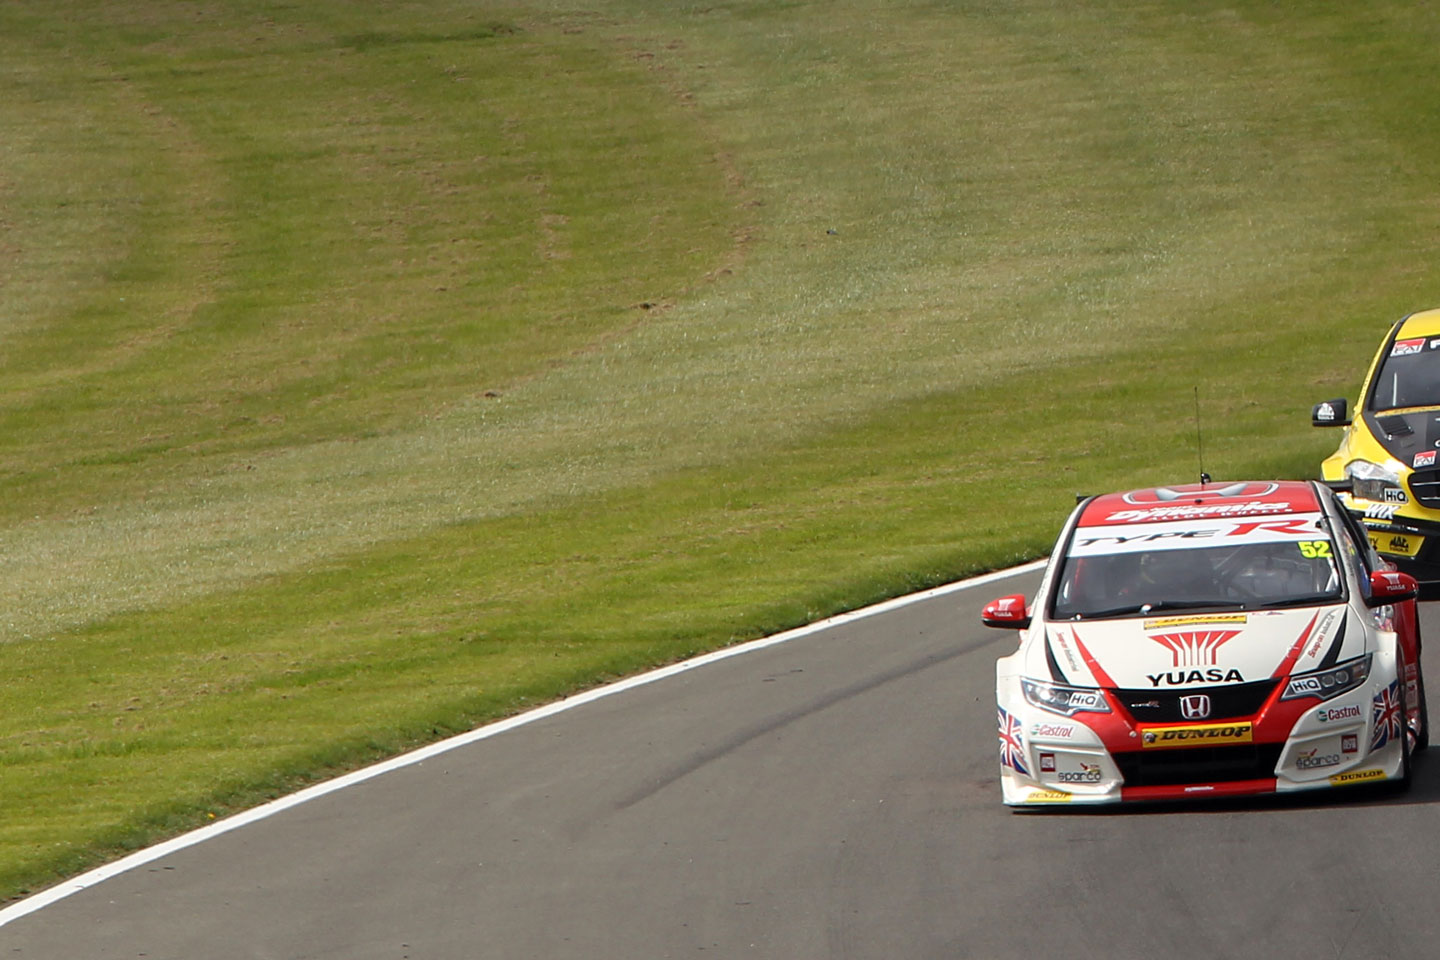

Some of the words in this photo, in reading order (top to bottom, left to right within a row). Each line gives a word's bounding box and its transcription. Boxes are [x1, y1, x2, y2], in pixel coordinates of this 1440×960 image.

[1386, 490, 1408, 502] HiQ
[1364, 503, 1400, 520] WIX
[1297, 540, 1335, 559] 52
[1146, 668, 1245, 688] YUASA
[1292, 678, 1320, 692] HiQ
[1071, 694, 1096, 706] HiQ
[1328, 705, 1361, 720] Castrol
[1039, 724, 1074, 738] Castrol
[1160, 724, 1251, 742] DUNLOP
[1340, 770, 1384, 782] DUNLOP
